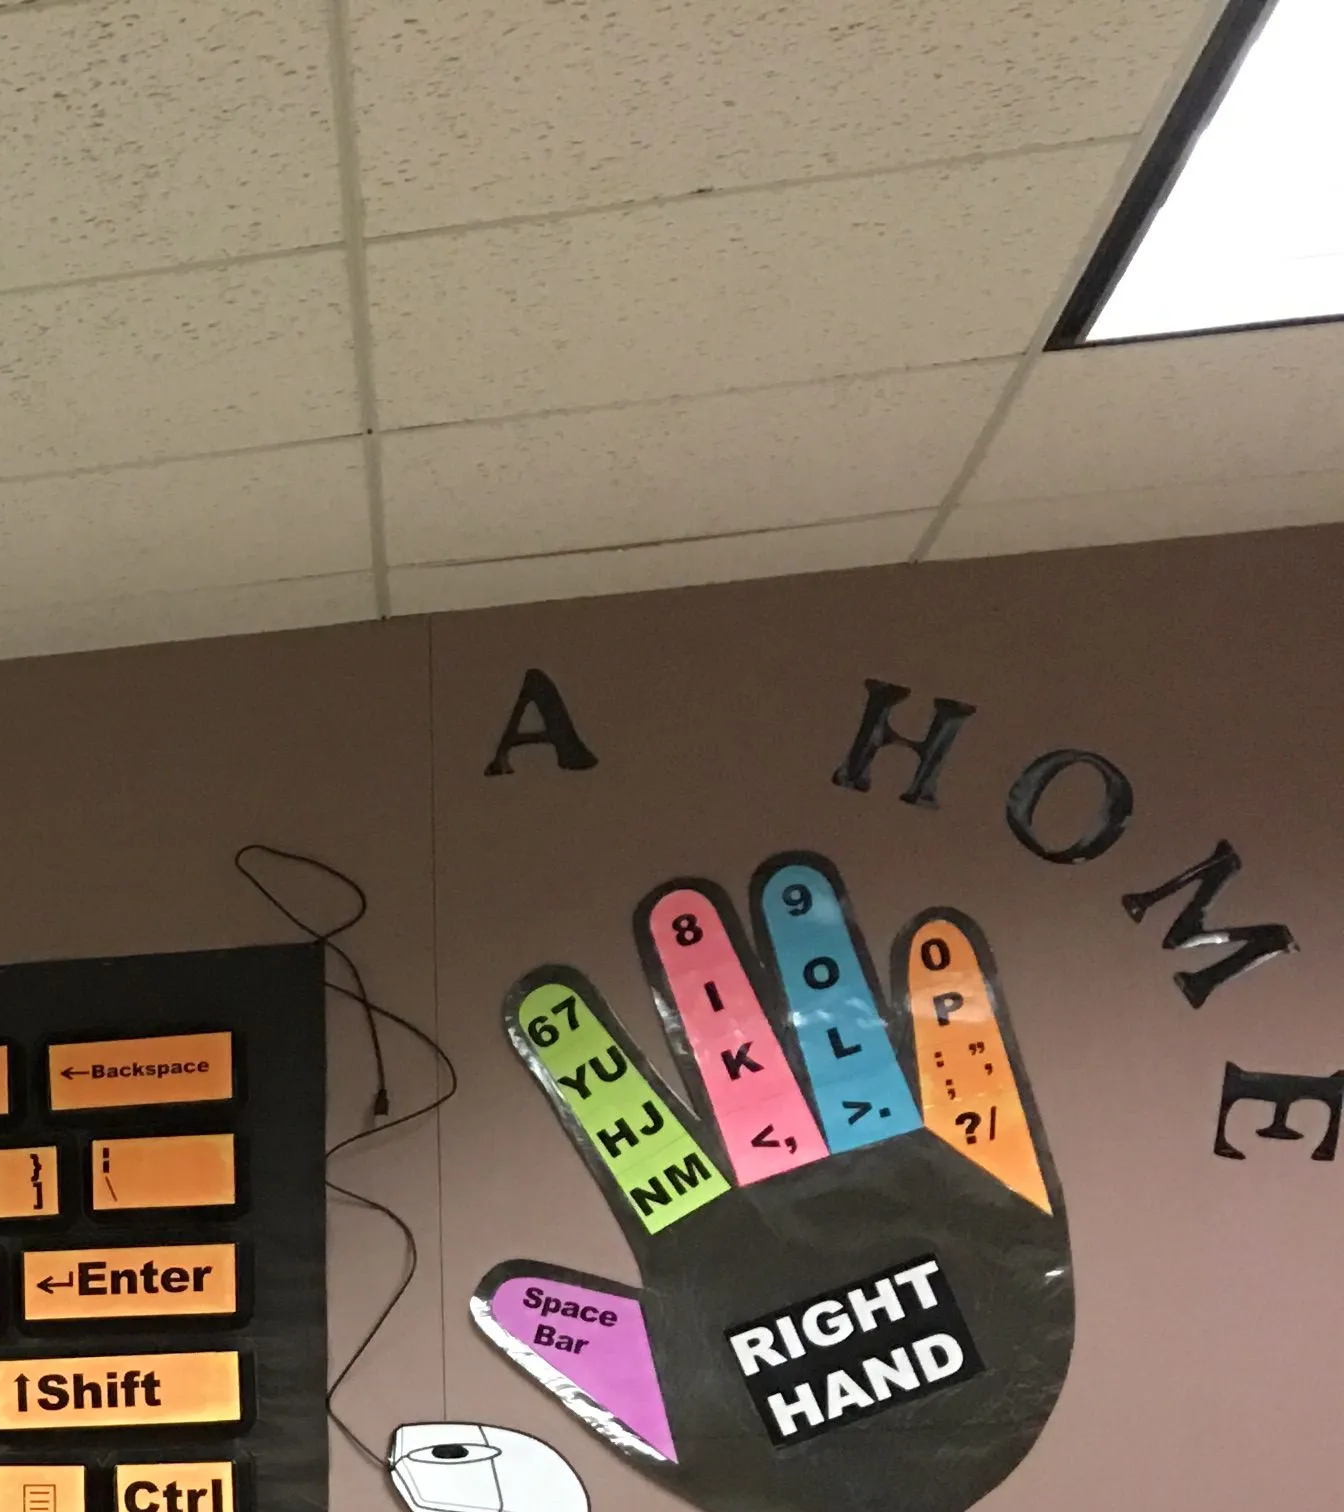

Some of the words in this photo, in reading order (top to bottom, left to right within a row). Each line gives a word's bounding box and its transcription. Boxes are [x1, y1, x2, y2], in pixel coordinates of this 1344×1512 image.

[483, 668, 599, 777] A
[782, 884, 812, 916] 9
[831, 678, 1344, 1162] HOME
[672, 914, 703, 946] 8
[528, 996, 579, 1047] 67
[933, 992, 964, 1027] P
[721, 1042, 763, 1080] K
[827, 1027, 861, 1059] L
[90, 1055, 211, 1082] Backspace
[557, 1046, 627, 1099] YU
[597, 1101, 664, 1158] HJ
[630, 1153, 711, 1216] NM
[77, 1260, 213, 1297] Enter
[523, 1283, 621, 1327] Space
[729, 1260, 941, 1378] RIGHT
[534, 1324, 589, 1354] Bar
[37, 1371, 162, 1410] Shift
[766, 1332, 964, 1436] HAND
